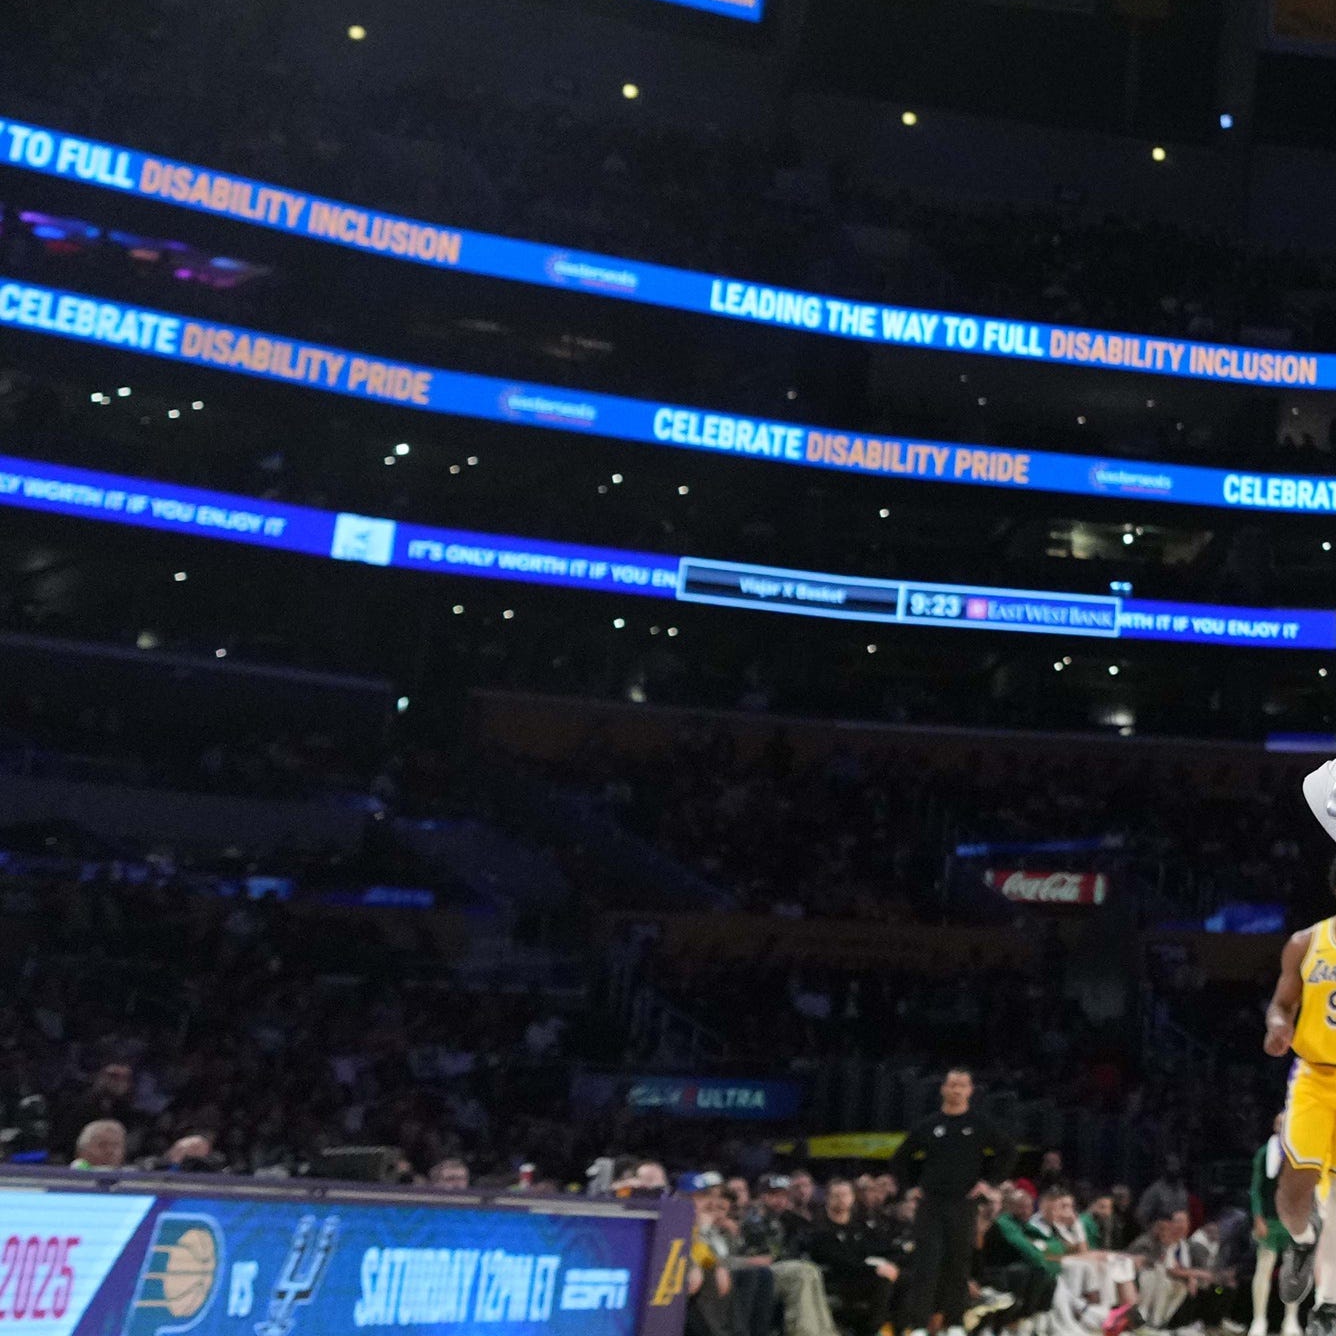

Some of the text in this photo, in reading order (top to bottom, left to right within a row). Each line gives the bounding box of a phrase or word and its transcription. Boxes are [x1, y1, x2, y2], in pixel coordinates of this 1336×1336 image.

[10, 126, 461, 263] TO FULL DISABILITY INCLUSION
[0, 285, 432, 404] CELEBRATE DISABILITY PRIDE
[711, 281, 1316, 384] LEADING THE WAY TO FULL DISABILITY INCLUSION
[655, 409, 1030, 483] CELEBRATE DISABILITY PRIDE
[446, 544, 495, 566] ONLY
[498, 550, 566, 575] WORTH
[570, 558, 587, 577] IT
[589, 561, 606, 579] IF
[612, 562, 647, 585] YOU
[911, 593, 961, 617] 9:23
[1156, 615, 1300, 639] IT IF YOU ENJOY IT
[0, 1235, 82, 1321] 2025
[356, 1246, 481, 1328] SATURDAY
[481, 1249, 533, 1324] 12PM
[533, 1253, 562, 1322] ET
[561, 1268, 631, 1311] ESPN
